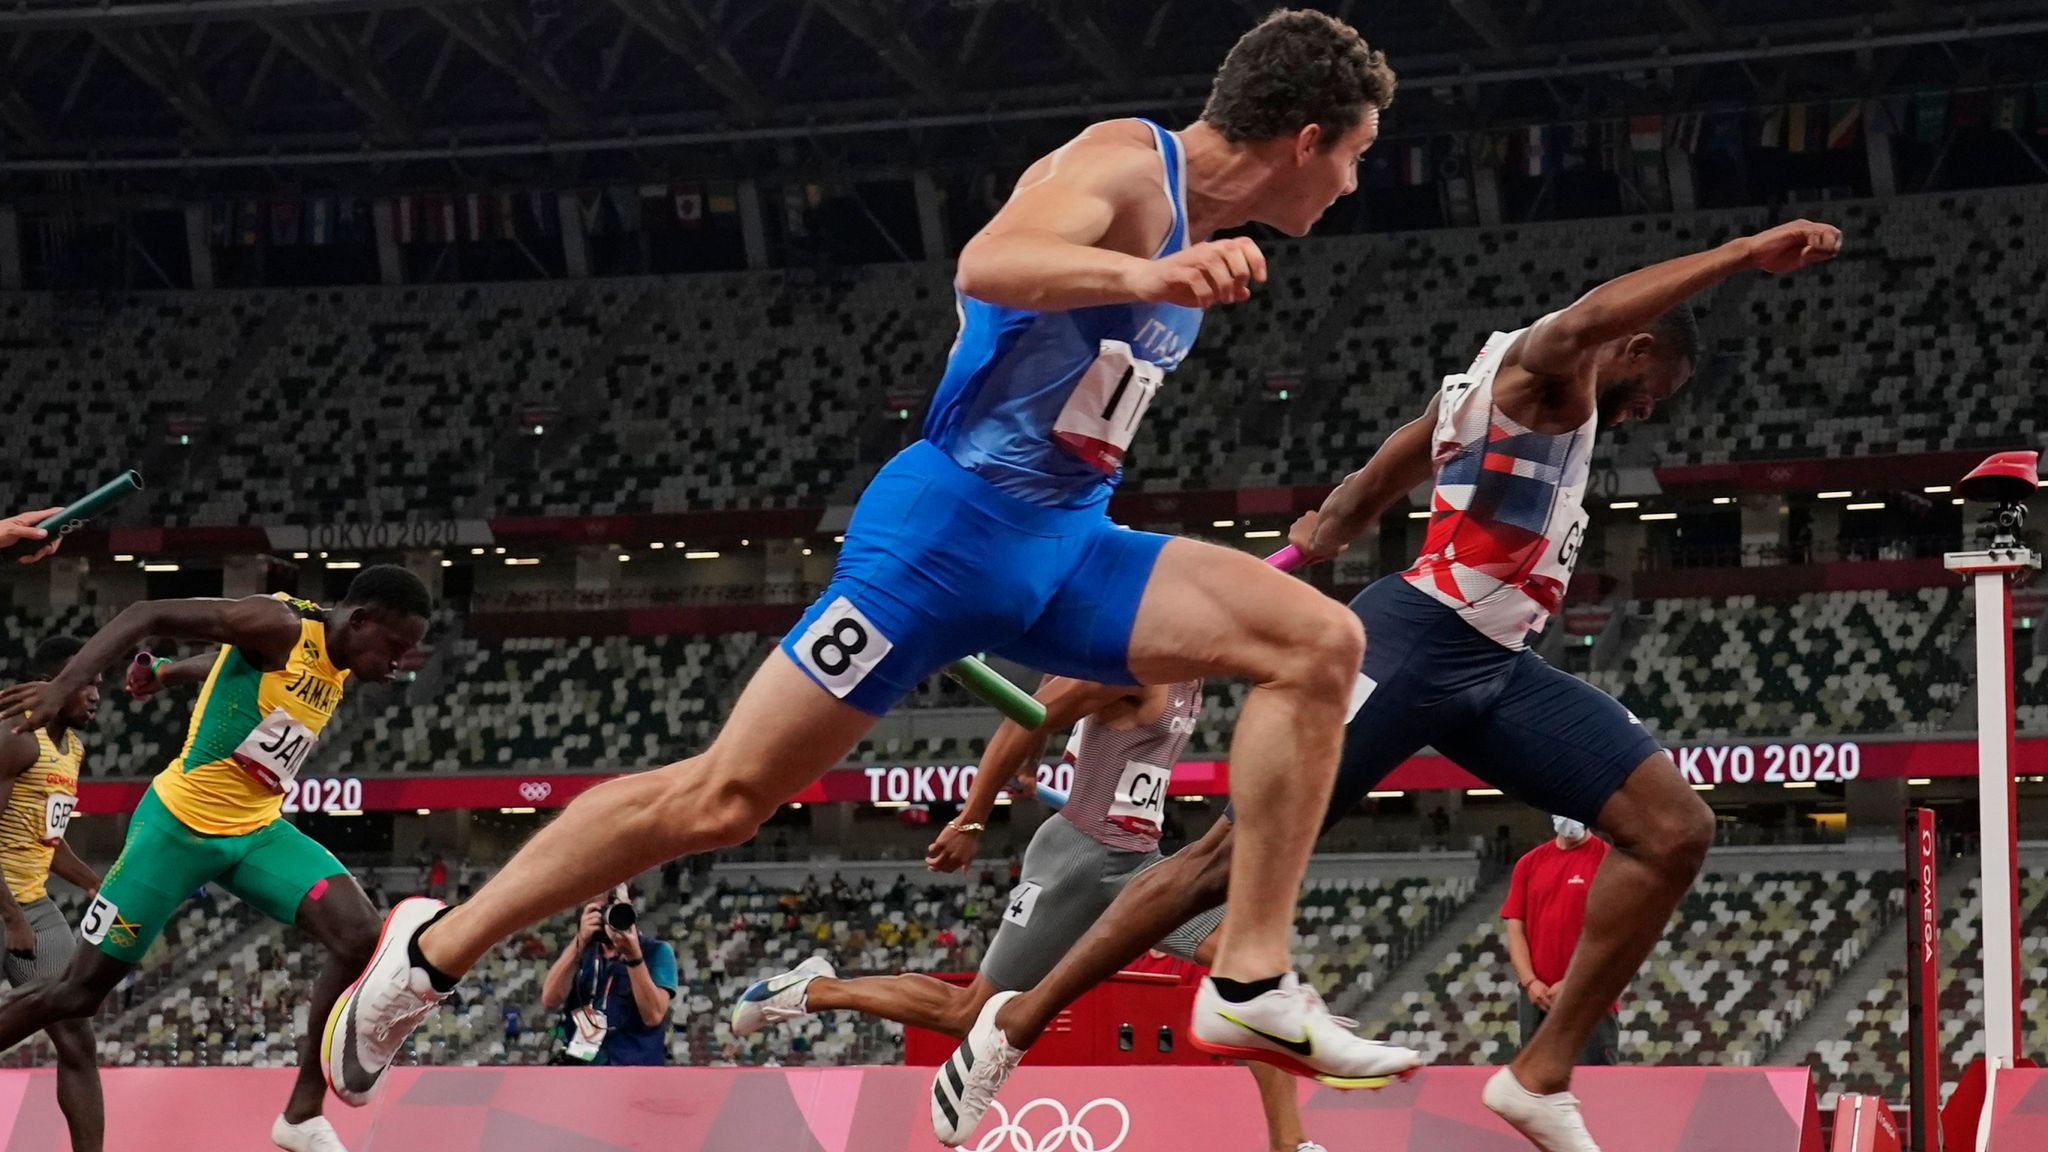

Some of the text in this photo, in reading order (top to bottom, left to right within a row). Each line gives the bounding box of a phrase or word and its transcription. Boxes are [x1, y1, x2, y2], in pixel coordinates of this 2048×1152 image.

[302, 520, 458, 550] TOKYO 2020
[811, 617, 868, 676] 8
[1763, 742, 1860, 782] 2020
[282, 778, 362, 813] 2020
[864, 764, 979, 802] TOKYO
[84, 899, 108, 936] 5
[1010, 886, 1031, 918] 4
[1923, 865, 1933, 963] OMEGA
